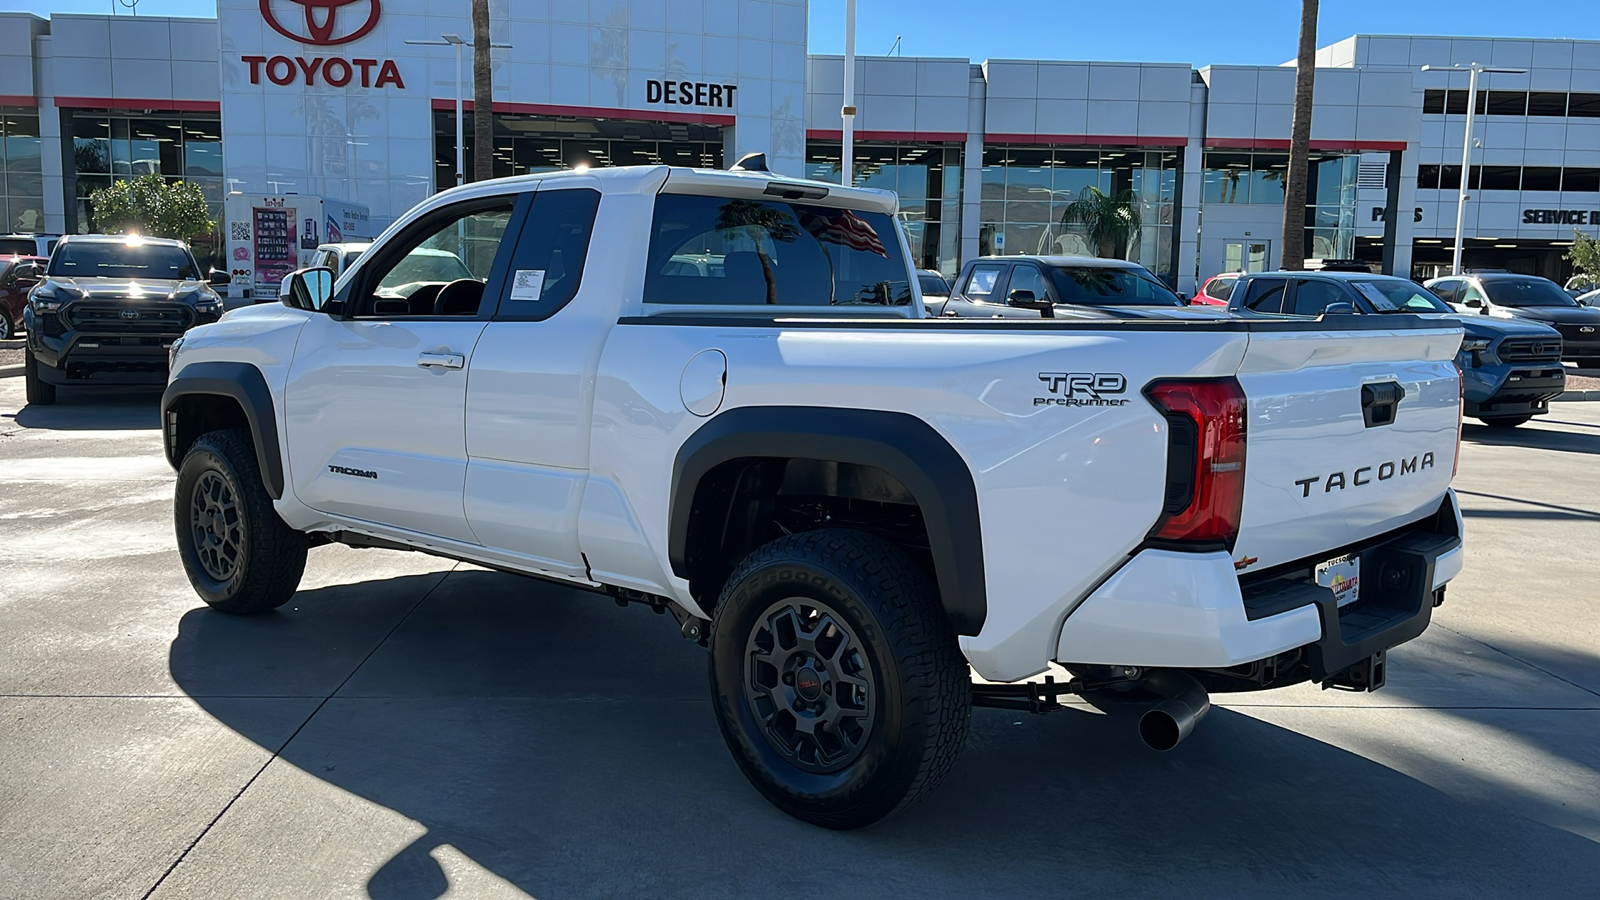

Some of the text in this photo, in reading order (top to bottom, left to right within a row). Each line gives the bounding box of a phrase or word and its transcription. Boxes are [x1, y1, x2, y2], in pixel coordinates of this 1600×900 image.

[241, 55, 405, 89] TOYOTA
[647, 79, 737, 108] DESERT
[1371, 206, 1423, 222] PAS
[1523, 209, 1588, 225] SERVICE
[1038, 372, 1127, 399] TRD
[328, 465, 378, 479] TACOMA
[1294, 451, 1435, 497] TACOMA
